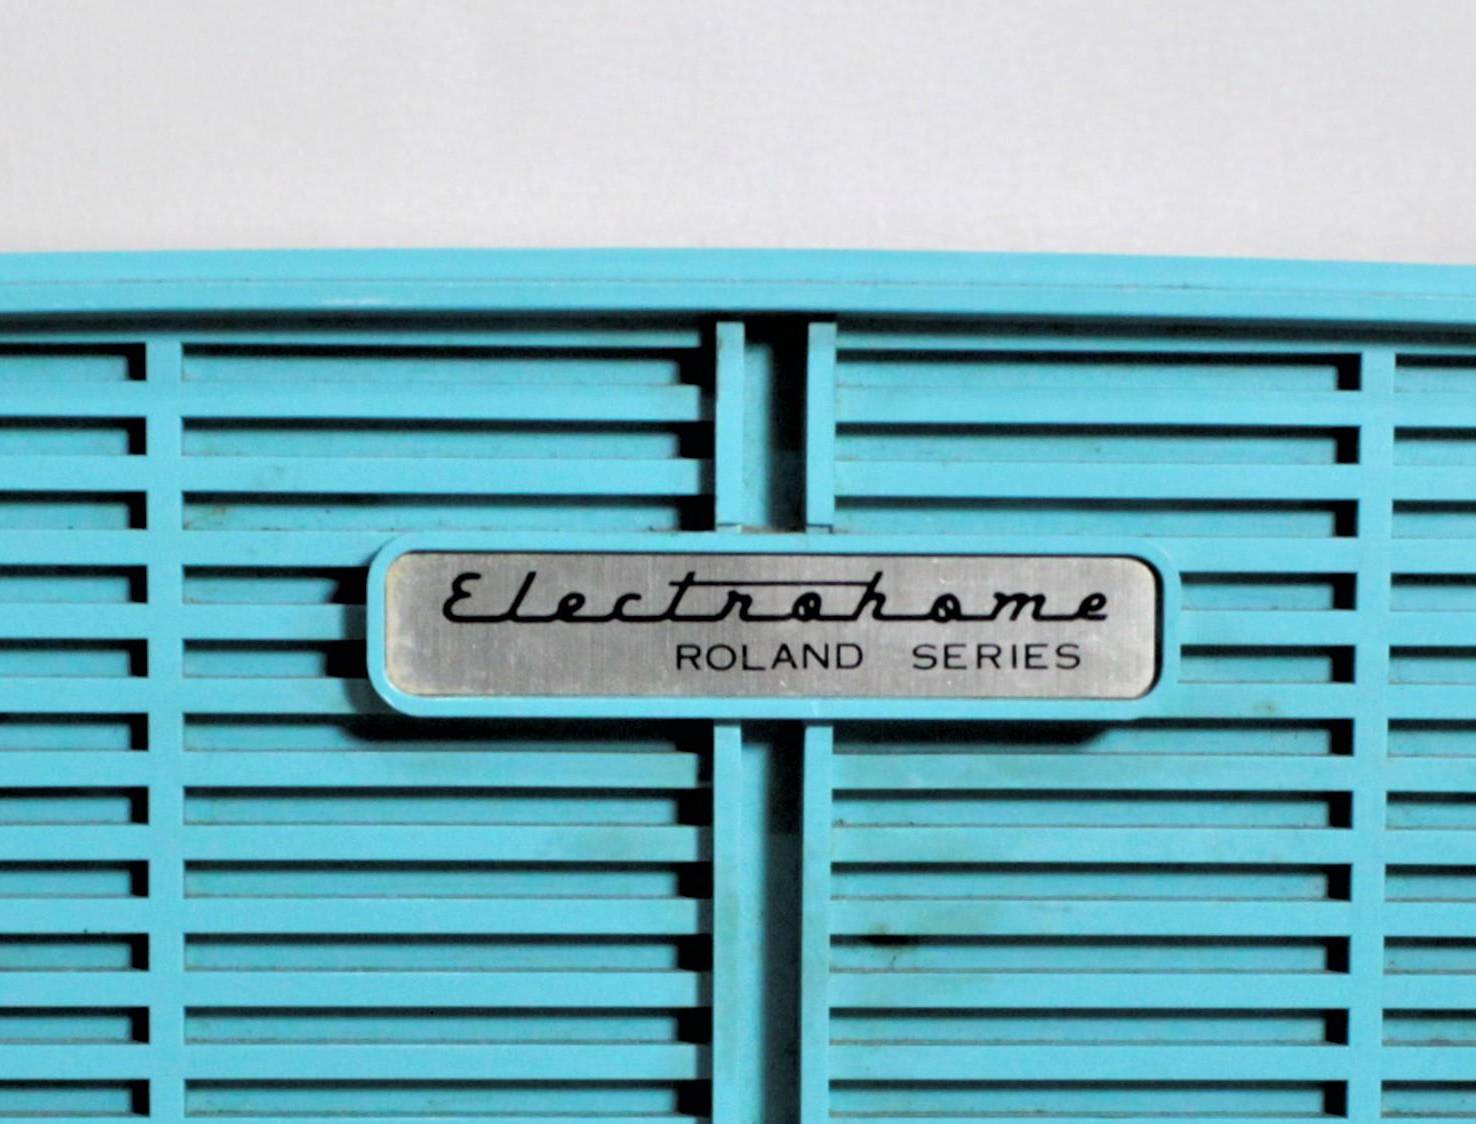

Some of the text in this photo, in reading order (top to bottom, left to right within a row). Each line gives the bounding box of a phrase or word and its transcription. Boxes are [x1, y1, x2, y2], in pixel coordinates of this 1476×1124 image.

[442, 571, 1107, 623] Electrohome
[675, 642, 1083, 671] ROLAND SERIES
